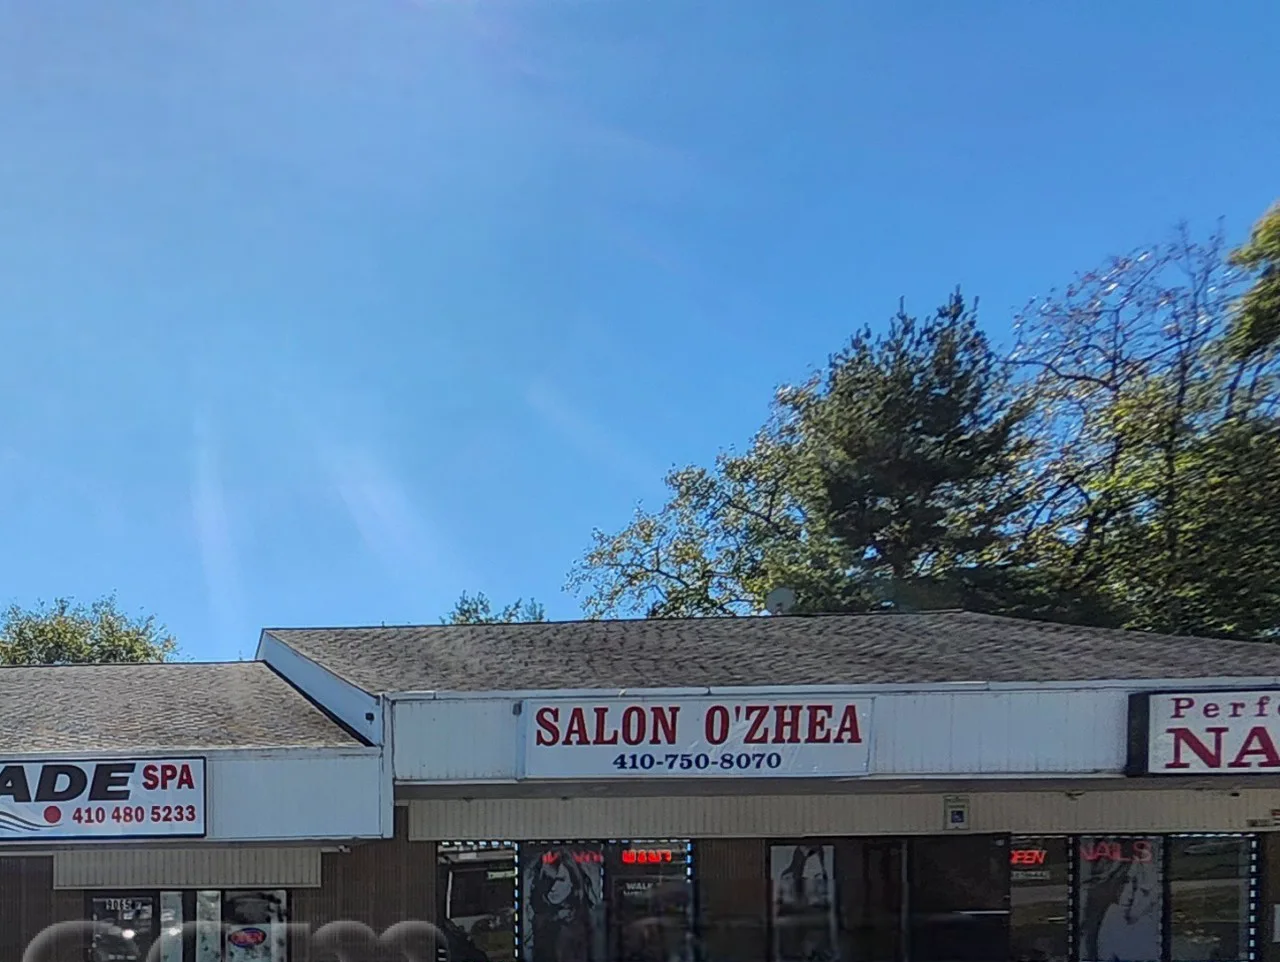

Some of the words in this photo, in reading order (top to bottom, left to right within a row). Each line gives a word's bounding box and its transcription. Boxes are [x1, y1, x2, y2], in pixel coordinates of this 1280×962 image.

[1169, 695, 1280, 719] Perf
[535, 706, 681, 746] SALON
[705, 704, 863, 745] O'ZHEA
[612, 752, 782, 770] 410-750-8070
[142, 764, 195, 790] SPA
[72, 807, 106, 824] 410
[111, 806, 145, 823] 480
[150, 805, 196, 823] 5233
